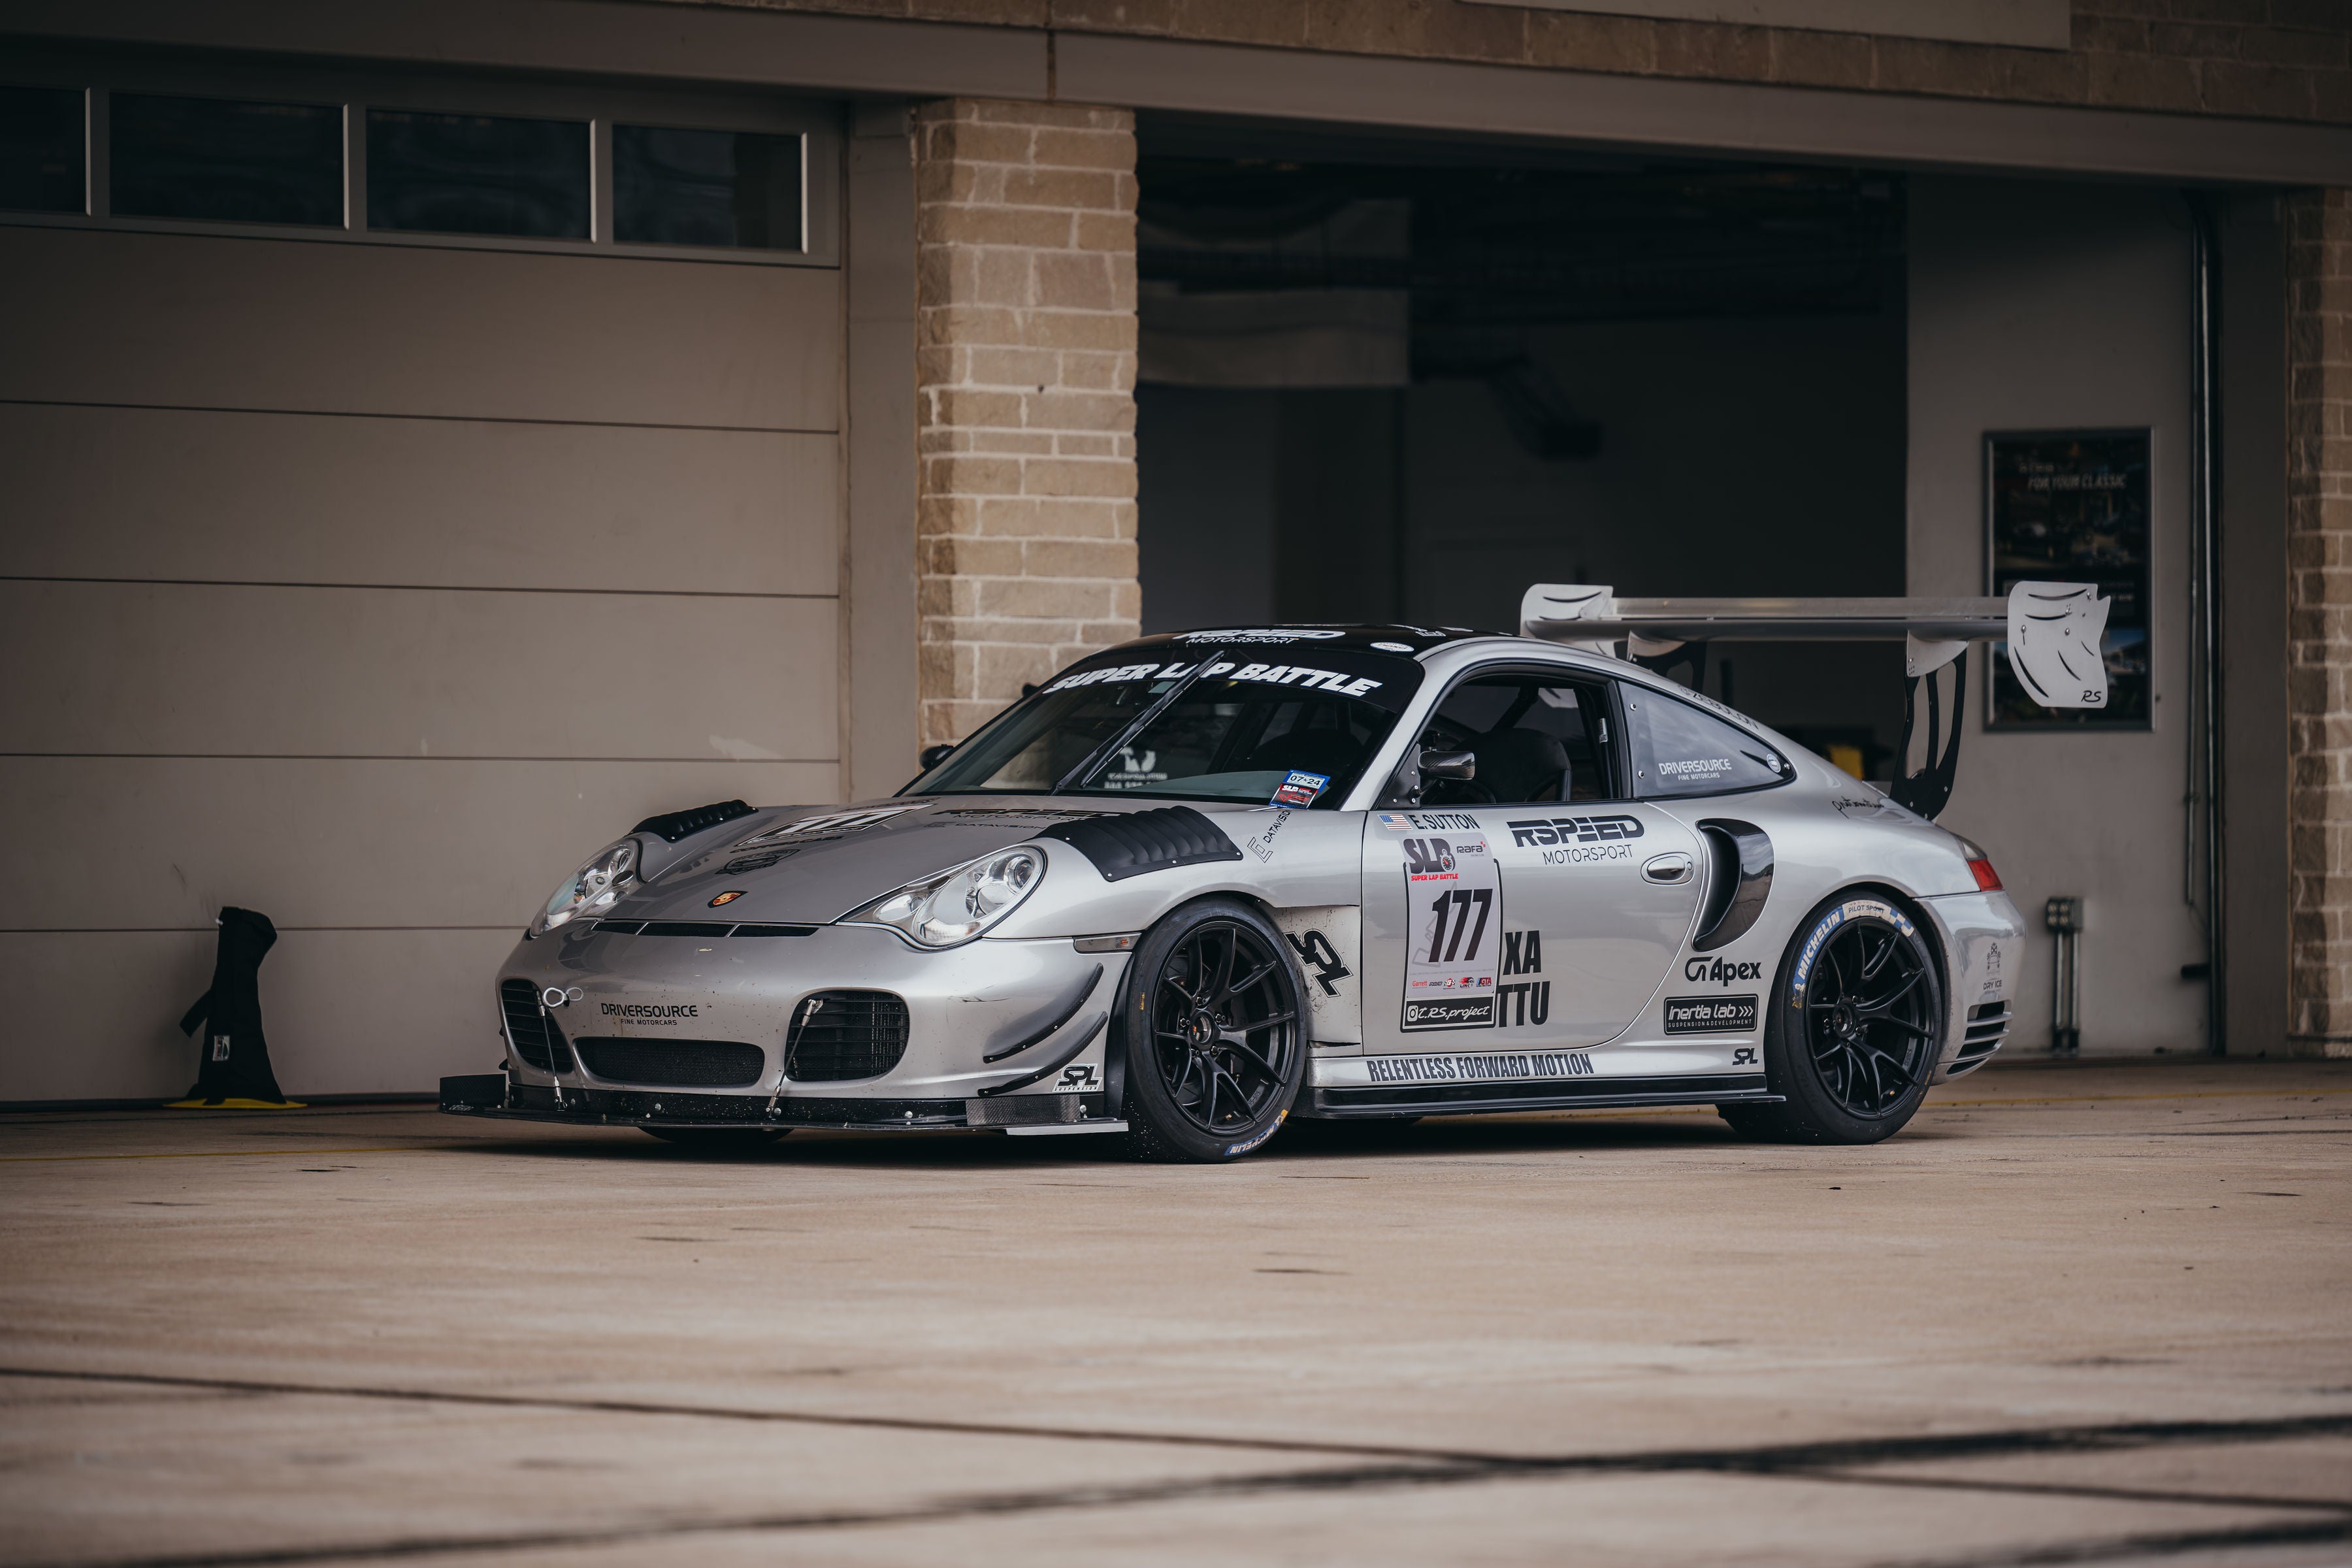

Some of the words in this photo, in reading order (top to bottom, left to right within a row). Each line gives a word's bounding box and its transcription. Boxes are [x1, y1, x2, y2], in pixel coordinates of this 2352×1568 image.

[1044, 663, 1160, 693] SUPER
[1228, 663, 1383, 697] BATTLE
[2081, 690, 2102, 702] RS
[1658, 759, 1732, 775] DRIVERSOURCE
[1263, 810, 1291, 843] DATAVISIO
[1506, 815, 1644, 847] RSPEED
[1403, 838, 1456, 874] SLB
[1543, 844, 1633, 864] MOTORSPORT
[1848, 905, 1865, 914] PILOT
[1866, 905, 1886, 914] SPORT
[1428, 889, 1493, 962] 177
[1503, 930, 1541, 975] XA
[1797, 911, 1841, 980] MICHELIN
[1983, 981, 1994, 990] DRY
[601, 1003, 698, 1017] DRIVERSOURCE
[1498, 981, 1550, 1028] TTU
[1669, 1005, 1712, 1021] inertia
[1714, 1004, 1737, 1019] lab
[1366, 1056, 1456, 1082] RELENTLESS
[1455, 1054, 1531, 1079] FORWARD
[1531, 1053, 1595, 1077] MOTION
[1732, 1047, 1759, 1066] SPL
[1057, 1066, 1100, 1086] SPL
